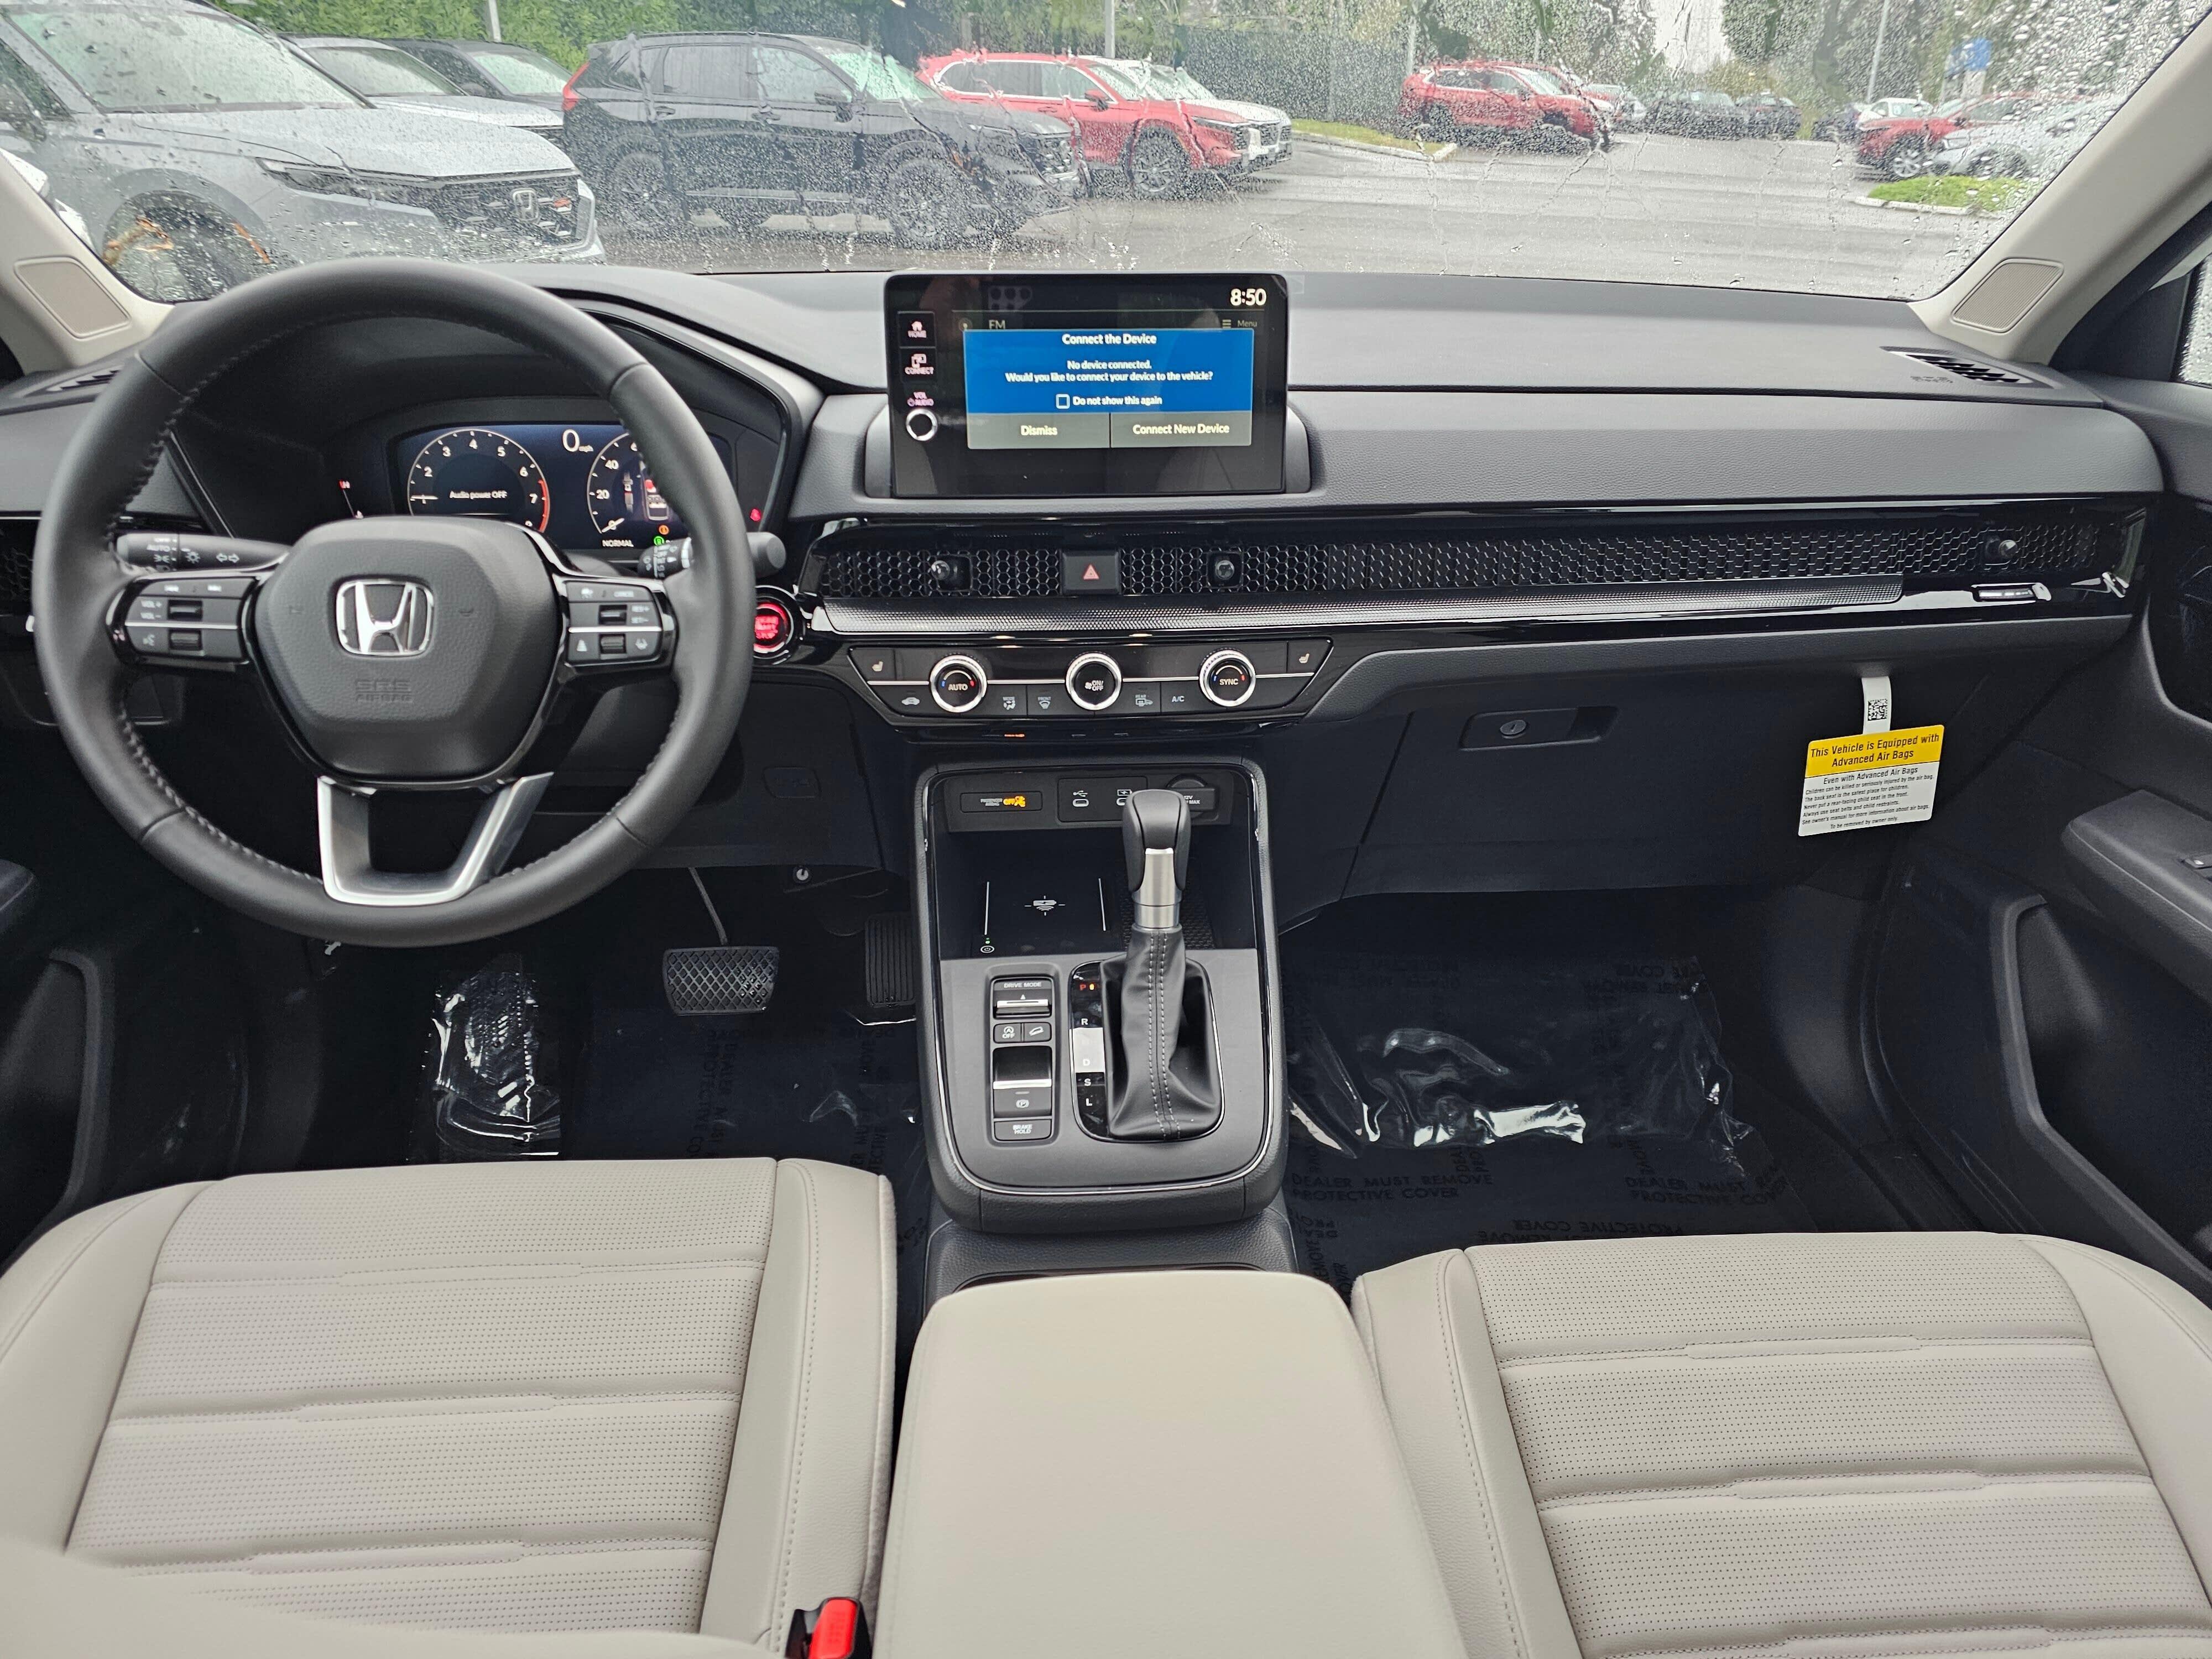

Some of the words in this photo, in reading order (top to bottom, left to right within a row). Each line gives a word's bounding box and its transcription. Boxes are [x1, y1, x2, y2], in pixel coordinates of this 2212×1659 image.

[1230, 288, 1267, 306] 8:50
[989, 320, 1005, 330] FM
[1062, 333, 1104, 345] Connect
[1105, 333, 1121, 345] the
[1123, 333, 1157, 344] Device
[1067, 360, 1081, 369] No
[1081, 360, 1107, 369] device
[1108, 359, 1152, 369] connected.
[1005, 373, 1033, 382] Would
[1034, 374, 1050, 383] you
[1051, 373, 1066, 382] like
[1066, 373, 1076, 382] to
[1076, 373, 1109, 382] connect
[1109, 373, 1129, 383] your
[1129, 372, 1156, 381] device
[1156, 372, 1166, 380] to
[1167, 372, 1181, 380] the
[1181, 371, 1213, 380] vehicle?
[1073, 396, 1086, 405] Do
[1086, 396, 1100, 405] not
[1101, 395, 1123, 405] show
[1124, 395, 1140, 405] this
[1140, 395, 1162, 406] again
[1021, 424, 1058, 436] Dismiss
[1132, 424, 1171, 435] Connect
[1173, 423, 1196, 435] New
[1197, 422, 1230, 435] Device
[469, 439, 478, 450] 4
[562, 429, 580, 452] 0
[442, 446, 451, 457] 3
[498, 446, 506, 457] 5
[605, 460, 619, 469] 40
[424, 466, 433, 477] 2
[520, 466, 528, 477] 6
[529, 493, 538, 504] 7
[596, 489, 610, 499] 20
[1811, 748, 1829, 758] This
[1832, 743, 1864, 754] Vehicle
[1867, 742, 1874, 750] is
[1877, 735, 1918, 750] Equipped
[1921, 734, 1939, 743] with
[1832, 754, 1875, 767] Advanced
[1877, 752, 1890, 761] Air
[1892, 750, 1914, 760] Bags
[1856, 770, 1889, 780] Advanced
[1292, 1173, 1352, 1187] DEALER
[1364, 1176, 1410, 1187] MUST
[1421, 1174, 1493, 1186] REMOVE
[1292, 1188, 1394, 1201] PROTECTIVE
[1402, 1187, 1459, 1199] COVER
